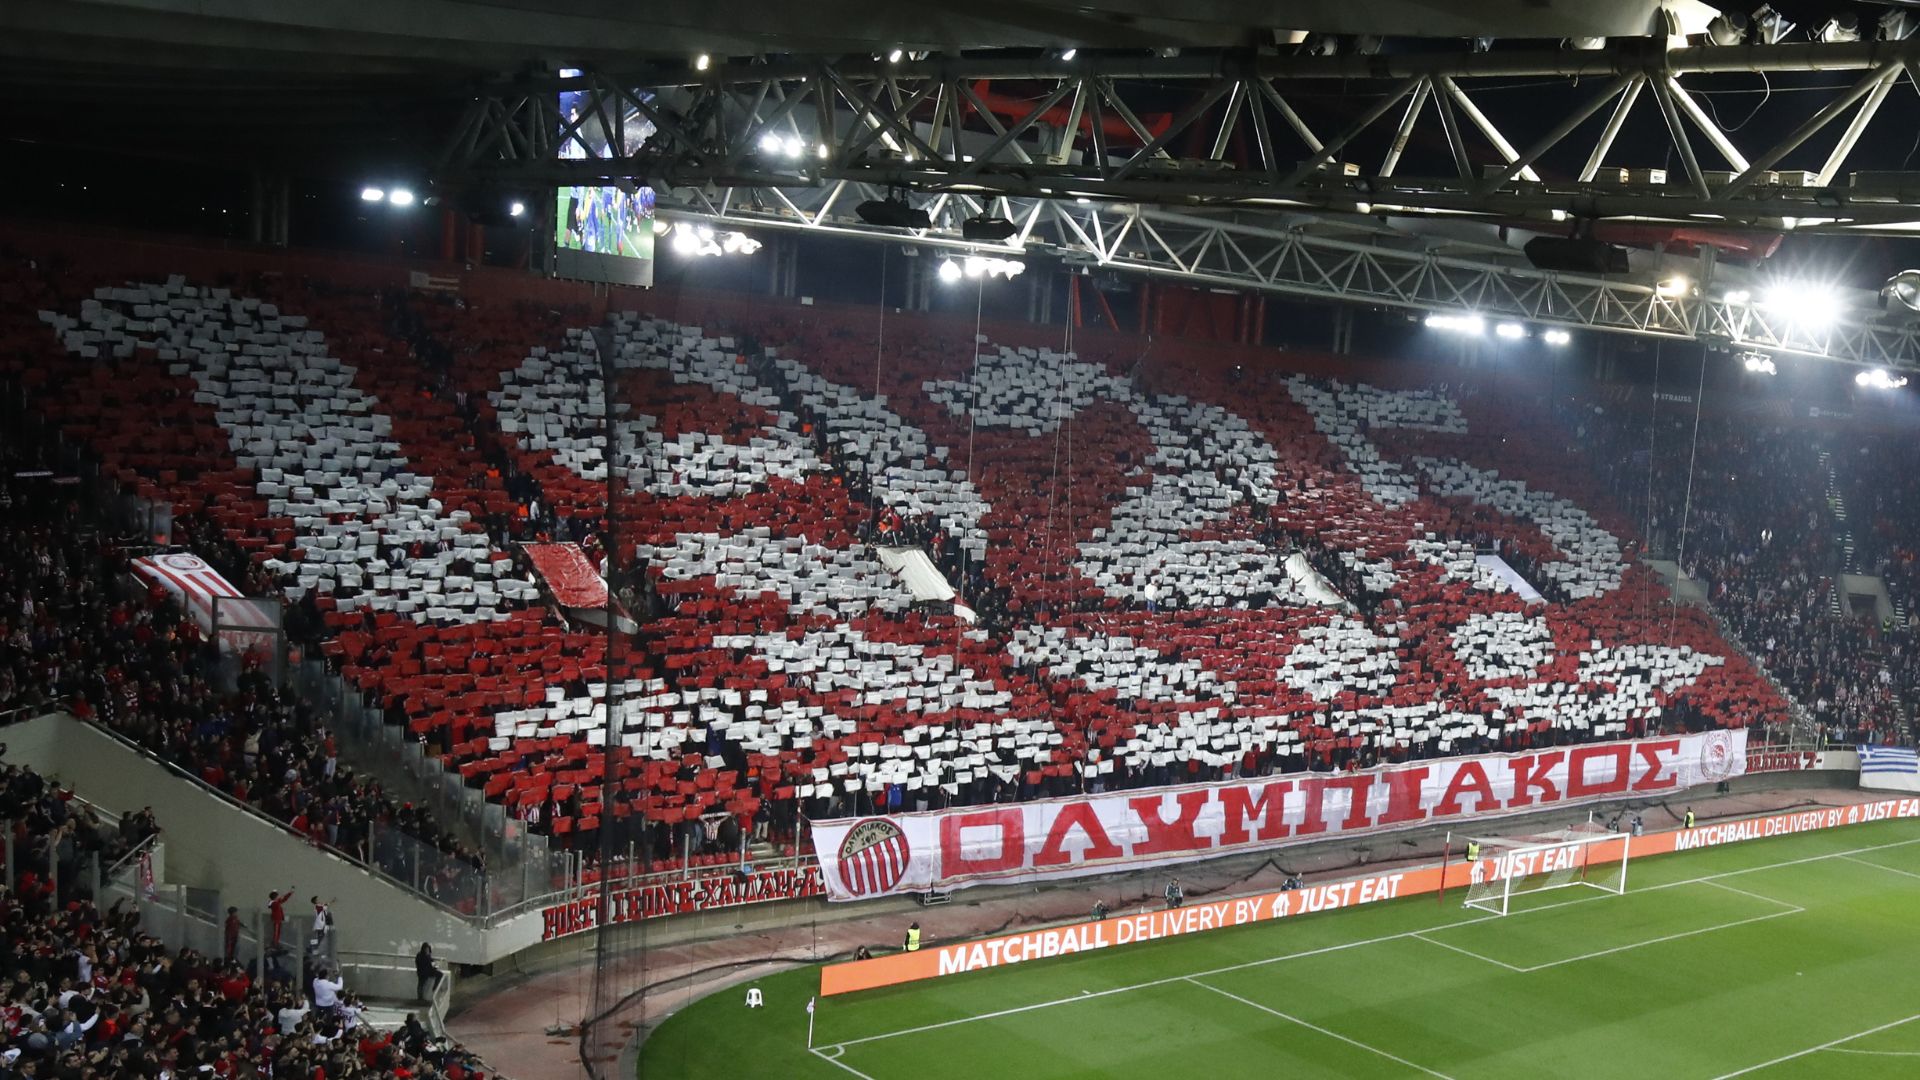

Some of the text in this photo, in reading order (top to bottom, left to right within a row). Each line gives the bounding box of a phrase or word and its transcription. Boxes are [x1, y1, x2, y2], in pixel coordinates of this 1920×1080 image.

[940, 740, 1681, 879] ΟΛΥΜΠΙΑΚΟΣ
[1675, 822, 1761, 850] MATCHBALL
[1764, 812, 1825, 837] DELIVERY
[1828, 808, 1844, 827] BY
[1860, 800, 1898, 822] JUST
[1490, 846, 1580, 881] JUST EAT
[939, 874, 1403, 976] MATCHBALL DELIVERY BY JUST EAT
